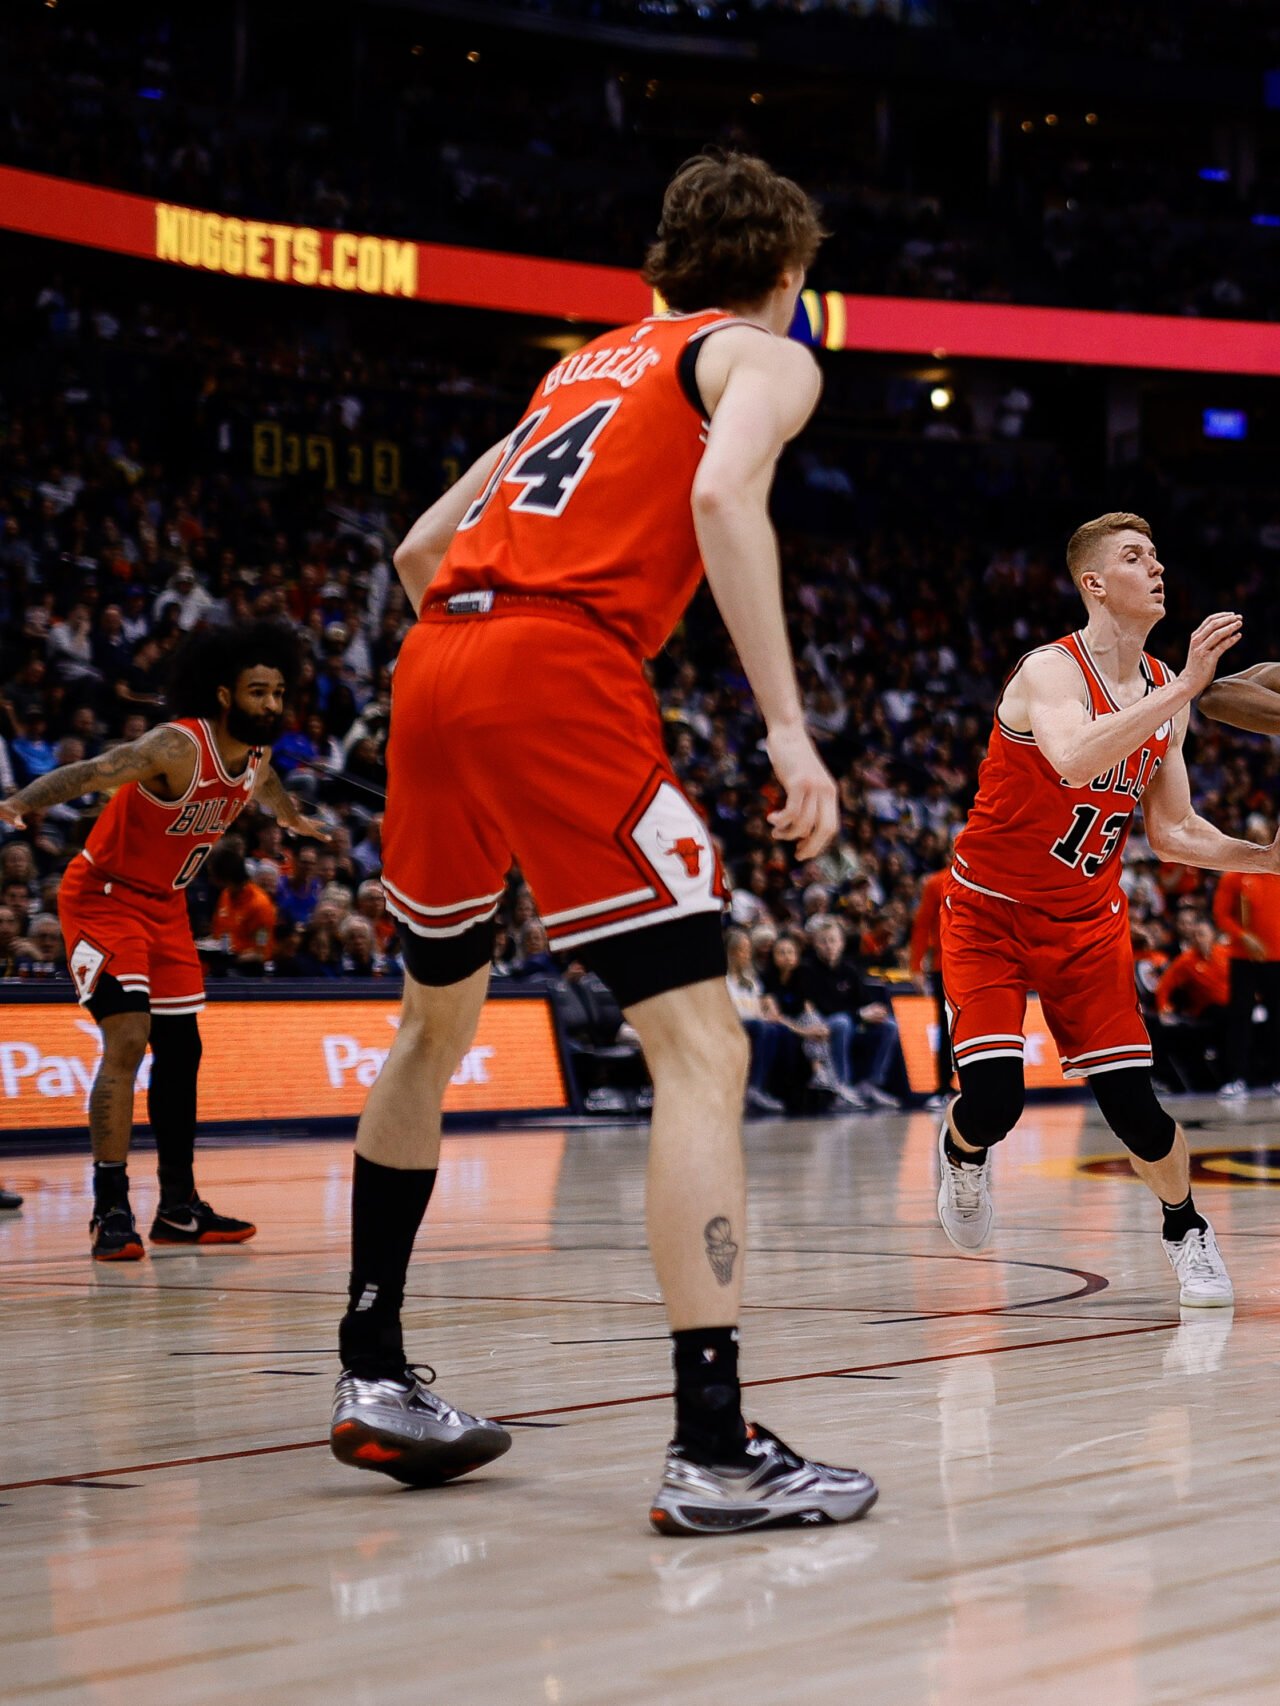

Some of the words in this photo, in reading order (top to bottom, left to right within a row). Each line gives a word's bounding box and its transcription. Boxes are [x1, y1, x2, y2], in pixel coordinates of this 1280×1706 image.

[155, 202, 418, 298] NUGGETS.COM
[456, 396, 623, 531] 14
[172, 843, 212, 890] 0
[1049, 803, 1131, 878] 13
